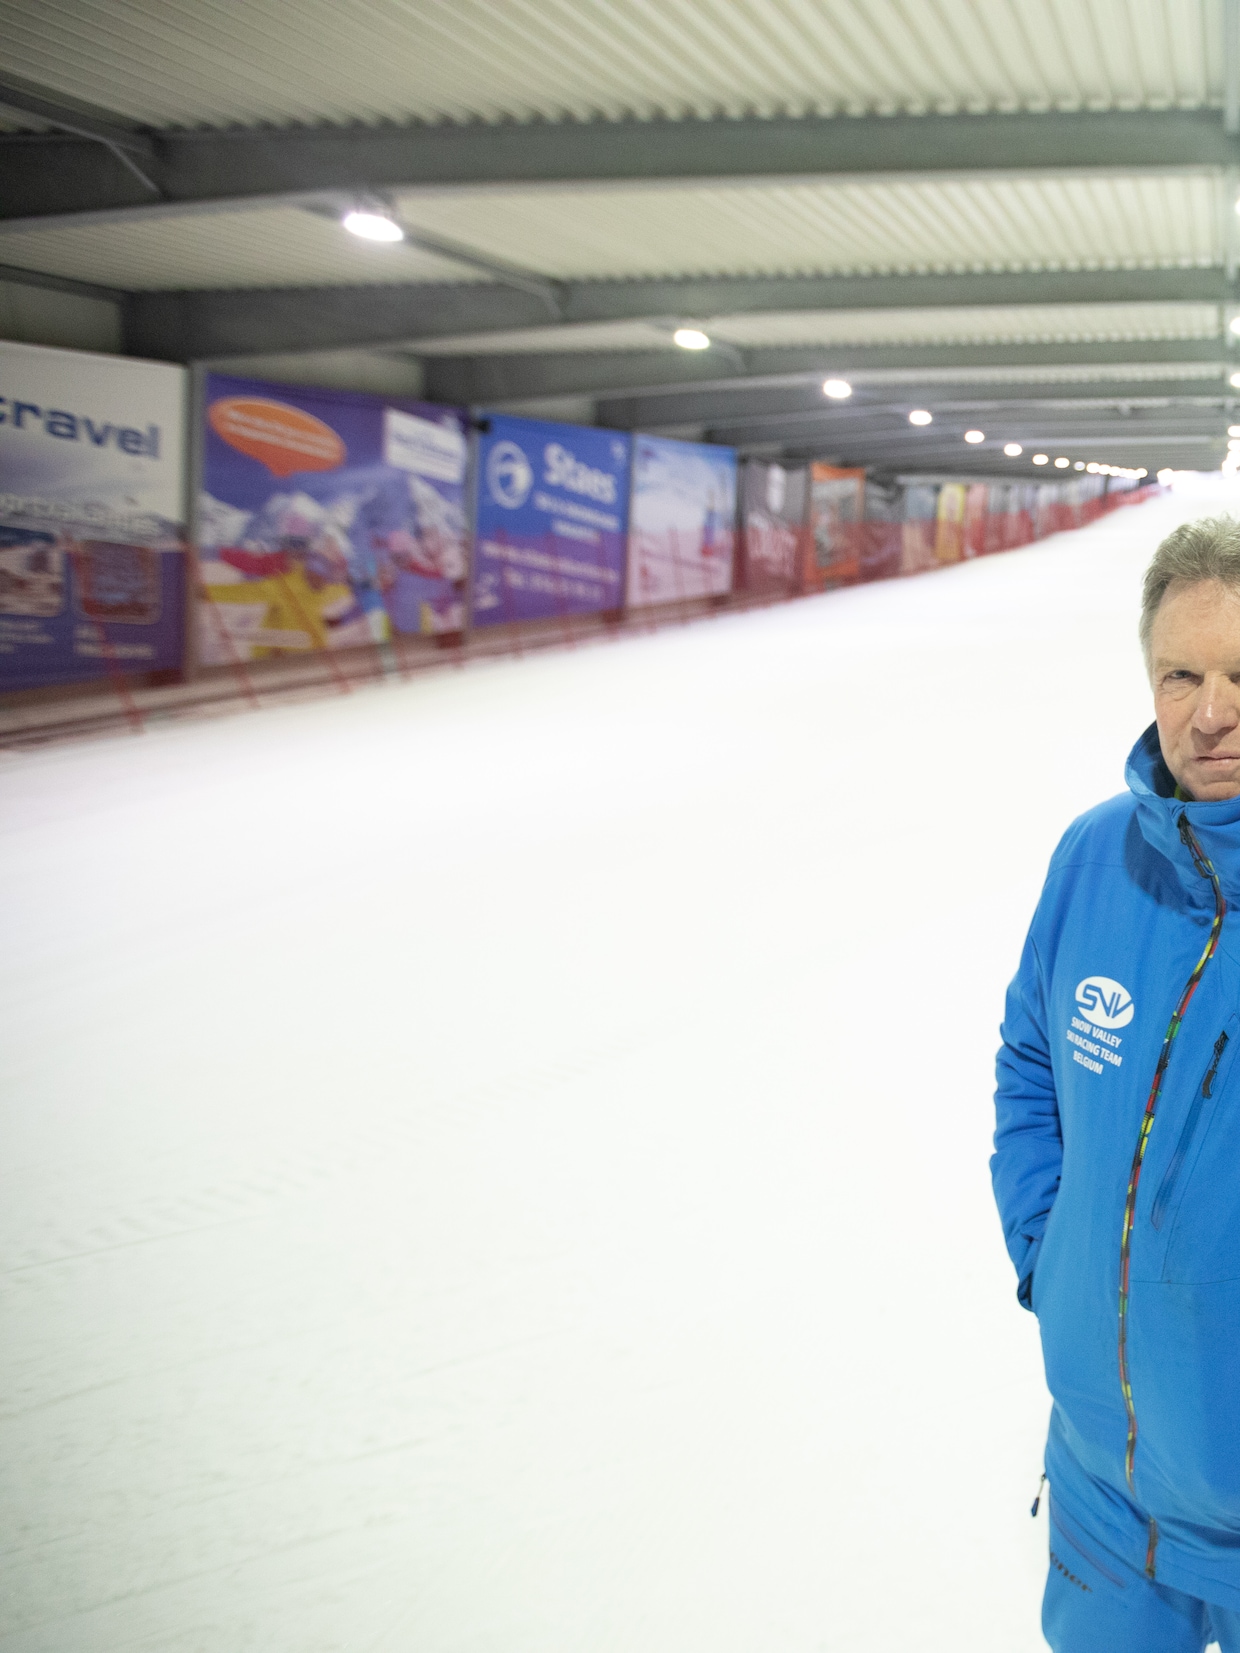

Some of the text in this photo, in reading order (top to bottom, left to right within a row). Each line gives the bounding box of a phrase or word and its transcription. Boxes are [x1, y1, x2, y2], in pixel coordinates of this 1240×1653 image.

[1071, 1016, 1123, 1048] SNOW VALLEY
[1072, 1050, 1104, 1075] BELGIUM
[1074, 1034, 1100, 1056] RACING
[1100, 1047, 1123, 1067] TEAM
